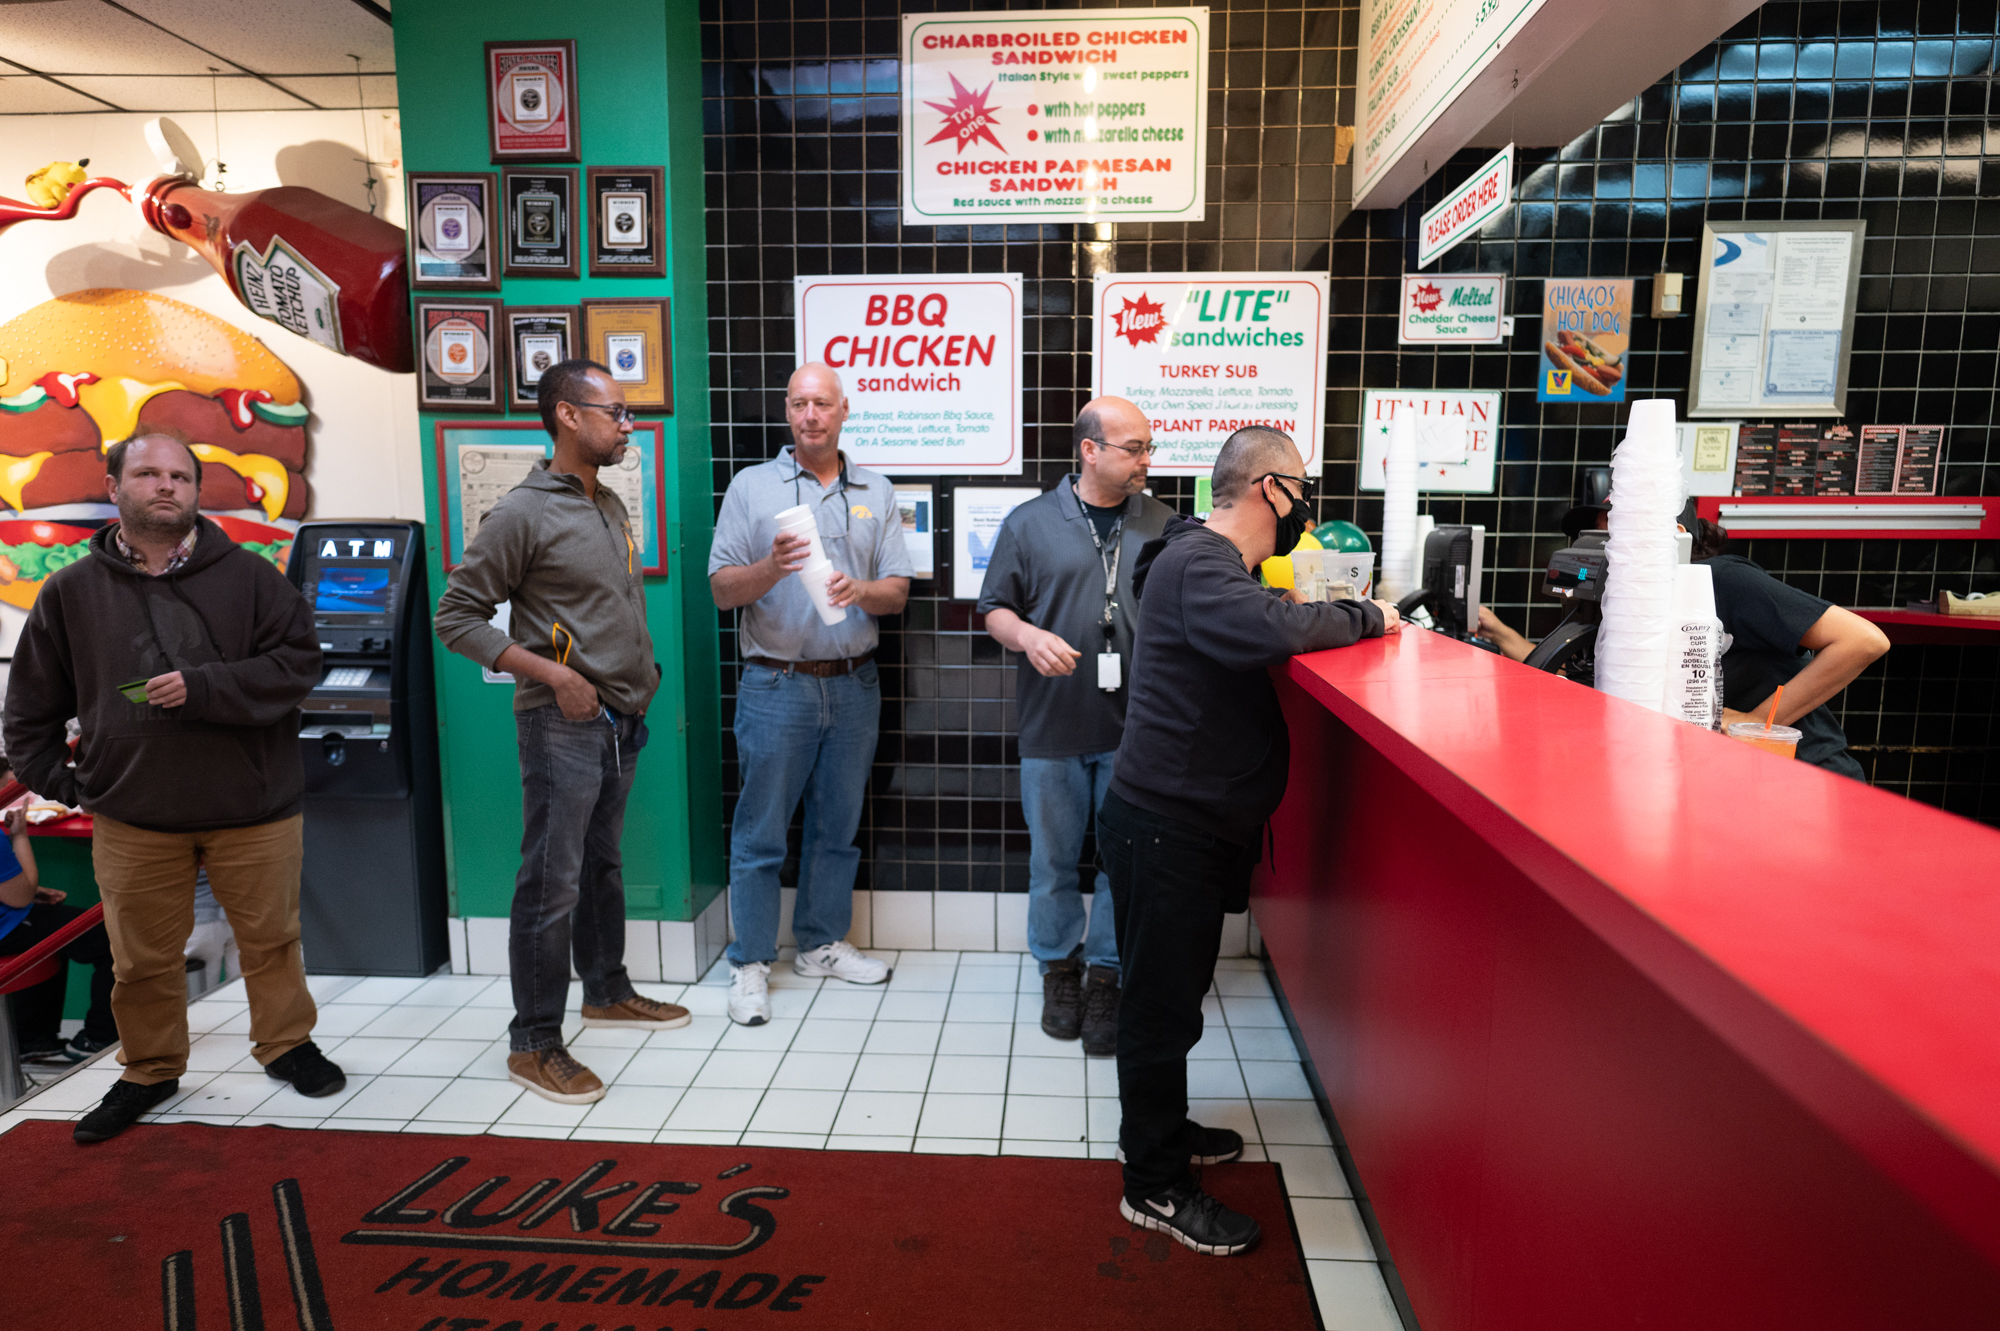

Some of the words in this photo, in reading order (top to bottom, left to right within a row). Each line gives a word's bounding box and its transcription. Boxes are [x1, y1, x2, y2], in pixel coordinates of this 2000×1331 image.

[922, 32, 1081, 50] CHARBROILED
[1087, 29, 1188, 46] CHICKEN
[991, 48, 1117, 66] SANDWICH
[998, 71, 1036, 82] Italian
[1039, 71, 1070, 84] Style
[1102, 70, 1138, 81] sweet
[1141, 69, 1189, 82] peppers
[951, 103, 977, 128] Try
[1044, 101, 1071, 117] with
[1073, 101, 1095, 117] hot
[1097, 101, 1146, 120] peppers
[958, 113, 988, 139] one
[1044, 128, 1071, 144] with
[1073, 126, 1138, 144] mzarella
[1142, 126, 1185, 143] cheese
[936, 160, 1038, 175] CHICKEN
[1045, 158, 1172, 174] PARMESAN
[953, 198, 975, 207] Red
[977, 199, 1012, 207] sauce
[1015, 197, 1041, 207] with
[1044, 196, 1108, 207] mozzara
[1111, 195, 1153, 206] cheese
[1427, 209, 1451, 248] PLEASE
[1452, 190, 1477, 229] ORDER
[1477, 171, 1499, 210] HERE
[246, 261, 271, 309] HEINZ
[269, 264, 295, 327] TOMATO
[1416, 290, 1440, 305] New
[1448, 286, 1495, 308] Melted
[1549, 284, 1616, 311] CHICAGO'S
[865, 293, 948, 327] BBQ
[1408, 314, 1454, 324] Cheddar
[1457, 313, 1496, 323] Cheese
[1120, 308, 1162, 333] New
[1435, 324, 1468, 334] Sauce
[1557, 310, 1588, 332] HOT
[1591, 310, 1622, 336] DOG
[1170, 327, 1304, 347] sandwiches
[823, 334, 996, 368] CHICKEN
[1160, 365, 1220, 378] TURKEY
[1226, 365, 1258, 378] SUB
[857, 372, 961, 392] sandwich
[1125, 386, 1156, 398] Turkey,
[1158, 386, 1215, 398] Mozzarella,
[1218, 387, 1253, 398] Lettuce,
[1257, 387, 1293, 397] Tomato
[1141, 400, 1160, 410] Our
[1161, 400, 1185, 410] Own
[863, 411, 894, 421] Breast,
[897, 410, 941, 420] Robinson
[943, 410, 962, 422] Bbq
[964, 411, 995, 421] Sauce,
[841, 424, 875, 434] merican
[877, 424, 915, 434] Cheese,
[918, 424, 952, 434] Lettuce,
[956, 424, 990, 433] Tomato
[1147, 419, 1203, 432] GPLANT
[855, 437, 870, 447] On
[871, 437, 879, 446] A
[881, 437, 919, 446] Sesame
[921, 437, 945, 446] Seed
[946, 437, 965, 446] Bun
[1169, 453, 1190, 462] And
[321, 540, 392, 558] ATM
[1692, 670, 1706, 679] 10
[352, 1156, 791, 1250] LUKE'S
[374, 1257, 827, 1312] HOMEMADE
